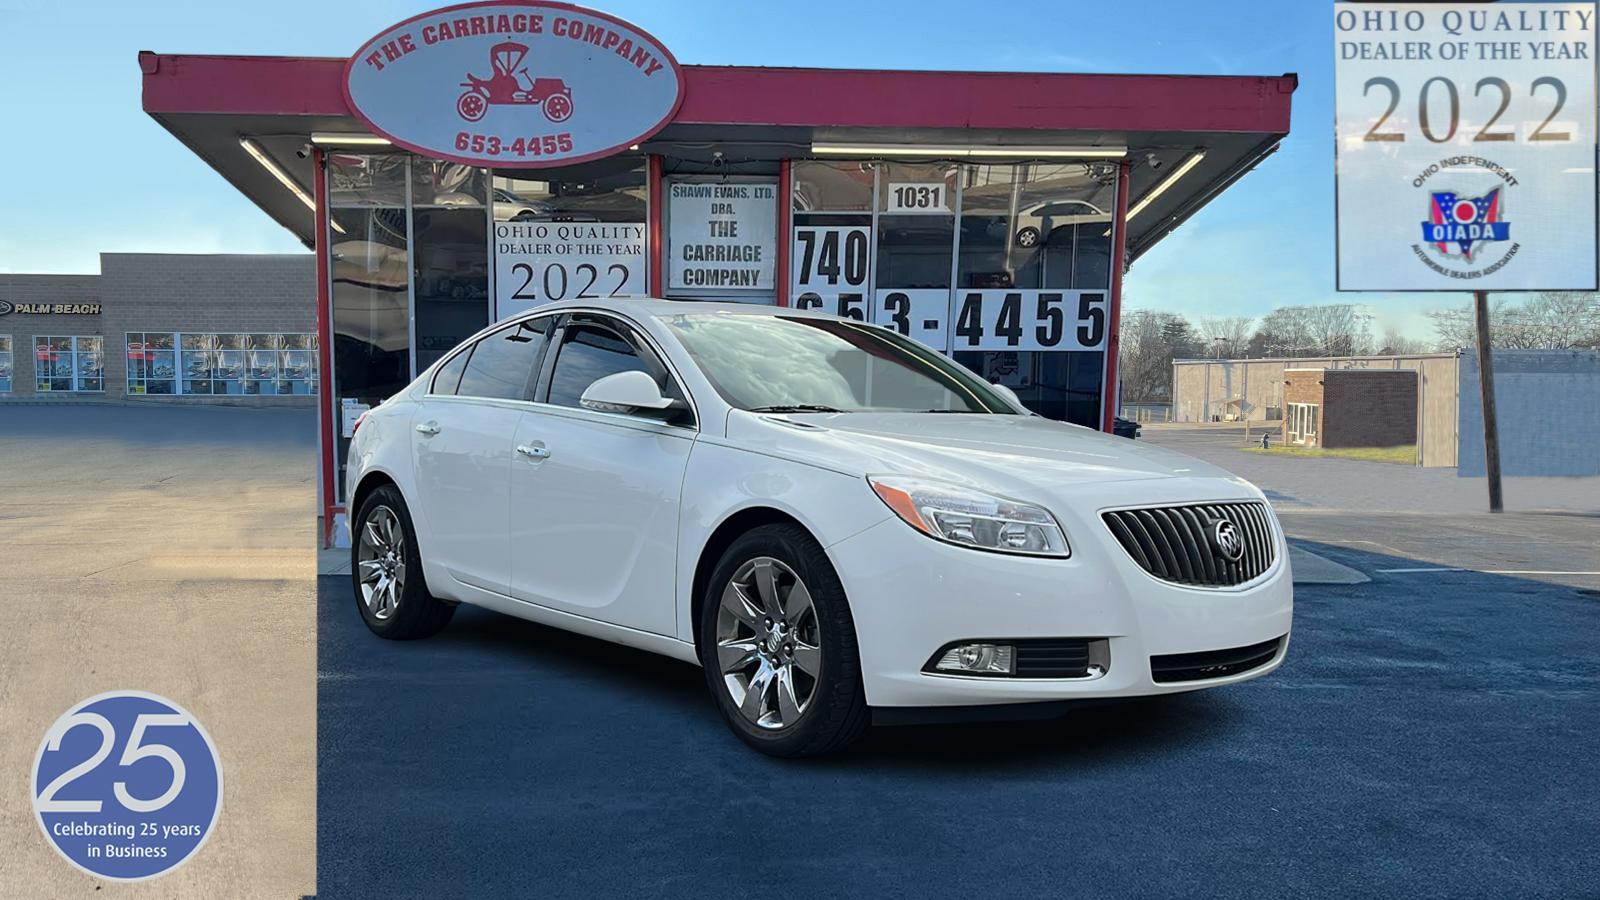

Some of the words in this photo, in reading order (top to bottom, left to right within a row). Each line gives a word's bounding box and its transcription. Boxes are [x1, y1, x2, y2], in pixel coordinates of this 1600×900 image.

[1336, 10, 1425, 32] OHIO
[1442, 10, 1593, 36] QUALITY
[366, 33, 417, 72] THE
[422, 14, 544, 46] CARRIAGE
[552, 16, 664, 78] COMPANY
[1340, 42, 1433, 60] DEALER
[1439, 42, 1470, 60] OF
[1475, 42, 1522, 60] THE
[1528, 42, 1589, 60] YEAR
[1362, 76, 1571, 143] 2022
[454, 131, 573, 156] 653-4455
[1412, 163, 1440, 188] OHIO
[1440, 155, 1519, 187] INDEPENDENT
[672, 186, 712, 199] SHAWN
[754, 187, 775, 200] LTD.
[894, 186, 941, 209] 1031
[711, 203, 736, 215] DBA.
[496, 225, 549, 239] OHIO
[557, 225, 645, 241] QUALITY
[708, 220, 738, 238] THE
[1432, 224, 1495, 241] OIADA
[499, 243, 552, 256] DEALER
[555, 243, 573, 256] OF
[576, 243, 603, 256] THE
[605, 243, 642, 256] YEAR
[682, 244, 762, 263] CARRIAGE
[796, 229, 869, 287] 740
[1411, 243, 1449, 277] AUTOMOBILE
[1449, 269, 1482, 280] DEALERS
[1482, 241, 1521, 277] ASSOCIATION
[510, 262, 632, 301] 2022
[682, 268, 760, 287] COMPANY
[14, 303, 51, 315] PALM
[54, 303, 101, 315] BEACH
